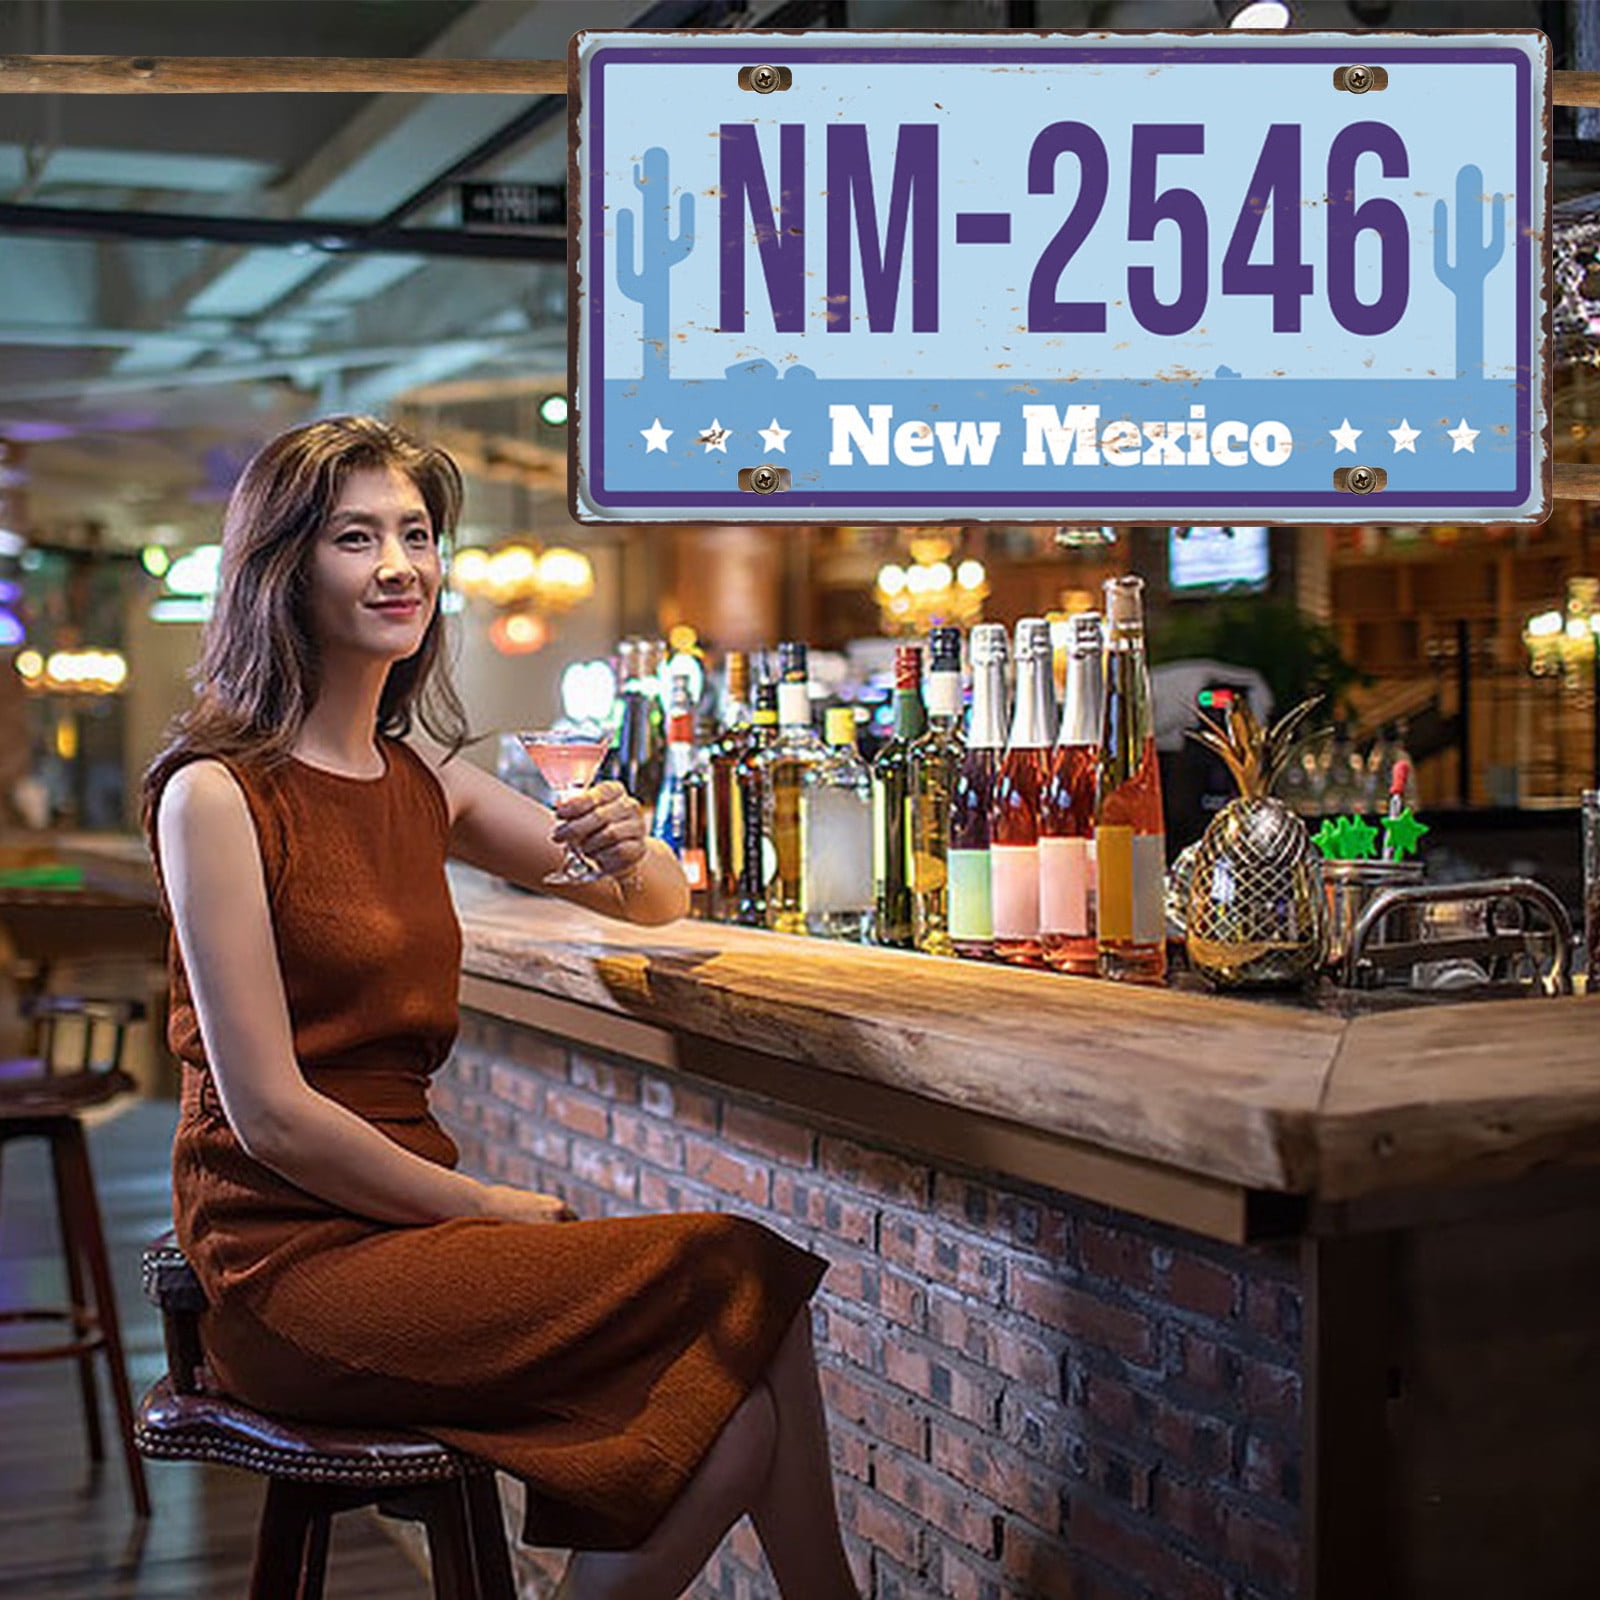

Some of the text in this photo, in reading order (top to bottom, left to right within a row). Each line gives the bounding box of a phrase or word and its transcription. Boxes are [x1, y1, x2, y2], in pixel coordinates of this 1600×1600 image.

[719, 121, 1410, 336] NM-2546
[829, 404, 1293, 467] New Mexico
